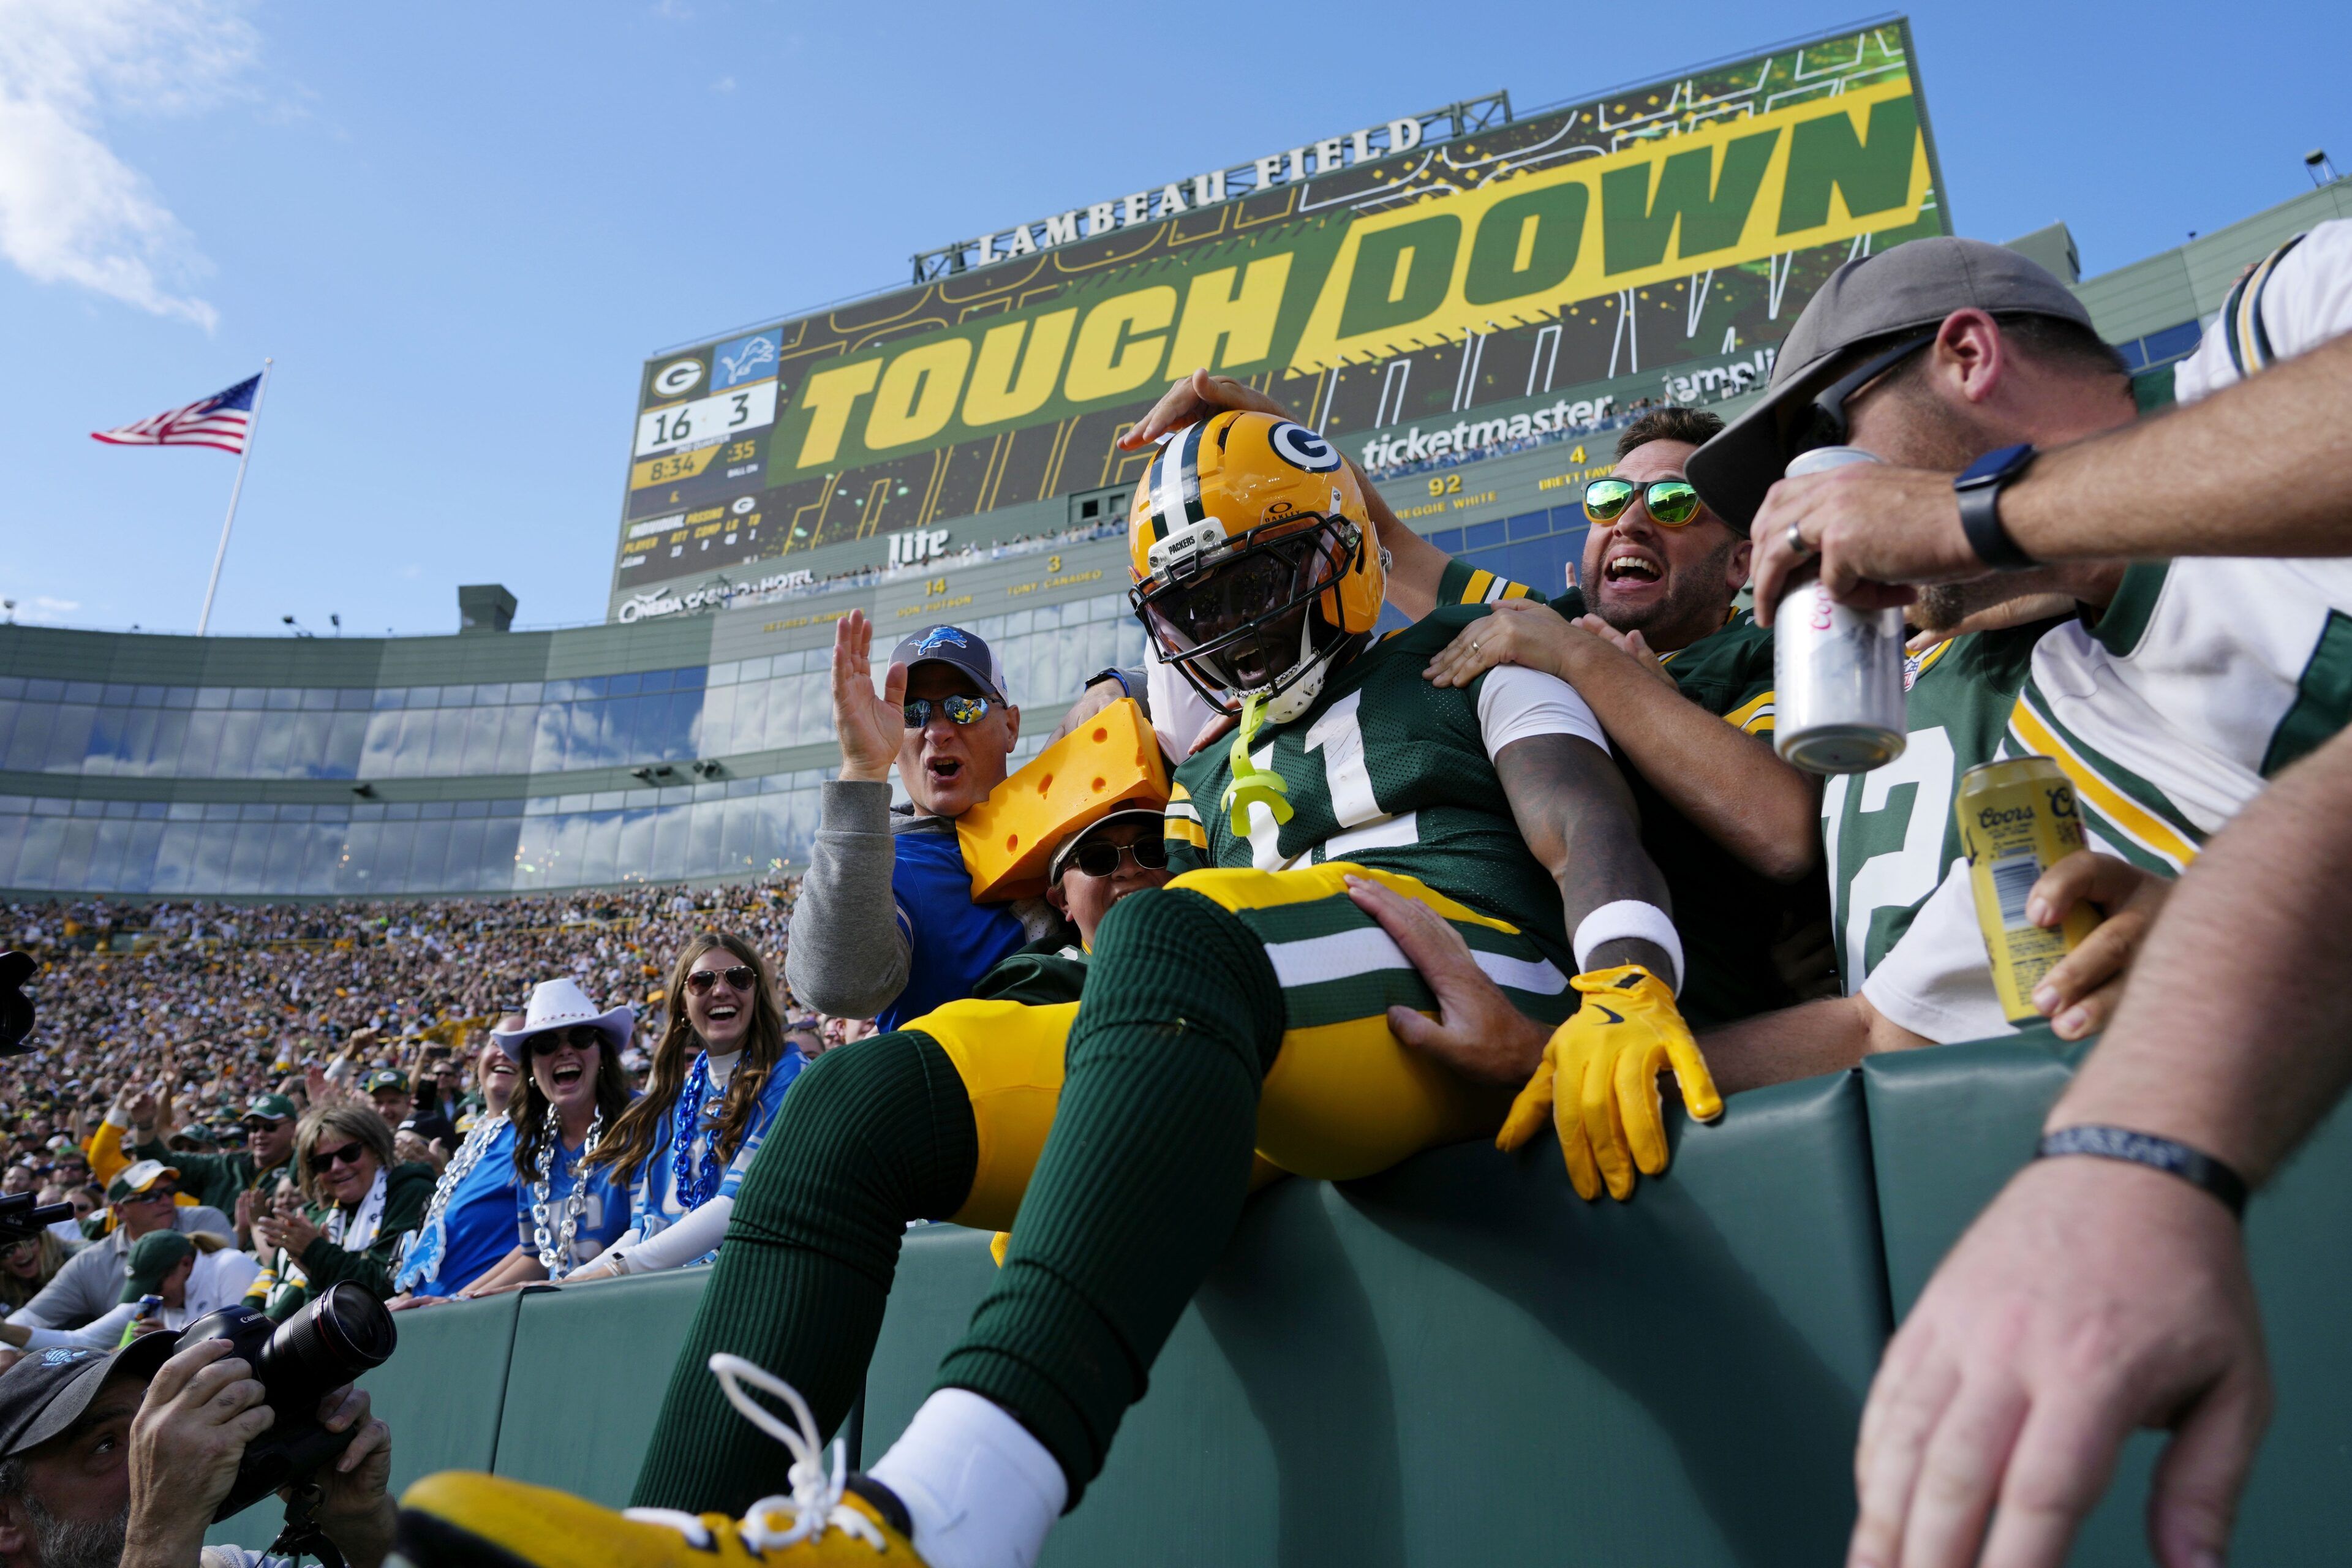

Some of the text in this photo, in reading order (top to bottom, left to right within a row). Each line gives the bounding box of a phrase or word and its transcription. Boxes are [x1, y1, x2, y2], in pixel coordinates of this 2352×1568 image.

[979, 117, 1422, 266] LAMBEAU FIELD
[796, 94, 1919, 469] TOUCH DOWN
[728, 393, 750, 427] 3
[652, 409, 691, 446] 16
[1361, 395, 1614, 470] ticketmaster
[1569, 445, 1587, 464] 4
[650, 455, 695, 481] 8:34
[1539, 464, 1617, 491] BRETT FAVR
[1428, 474, 1462, 497] 92
[1395, 491, 1497, 519] REGGIE WHITE
[888, 529, 949, 568] lite
[1168, 535, 1196, 555] PACKERS
[1047, 555, 1061, 573] 3
[760, 569, 813, 592] HOTEL
[924, 578, 946, 597] 14
[1007, 569, 1102, 597] TONY CANADEO
[812, 607, 865, 624] NUMBES
[897, 604, 920, 617] DON
[1977, 805, 2035, 829] Coors
[239, 1313, 264, 1323] Canon
